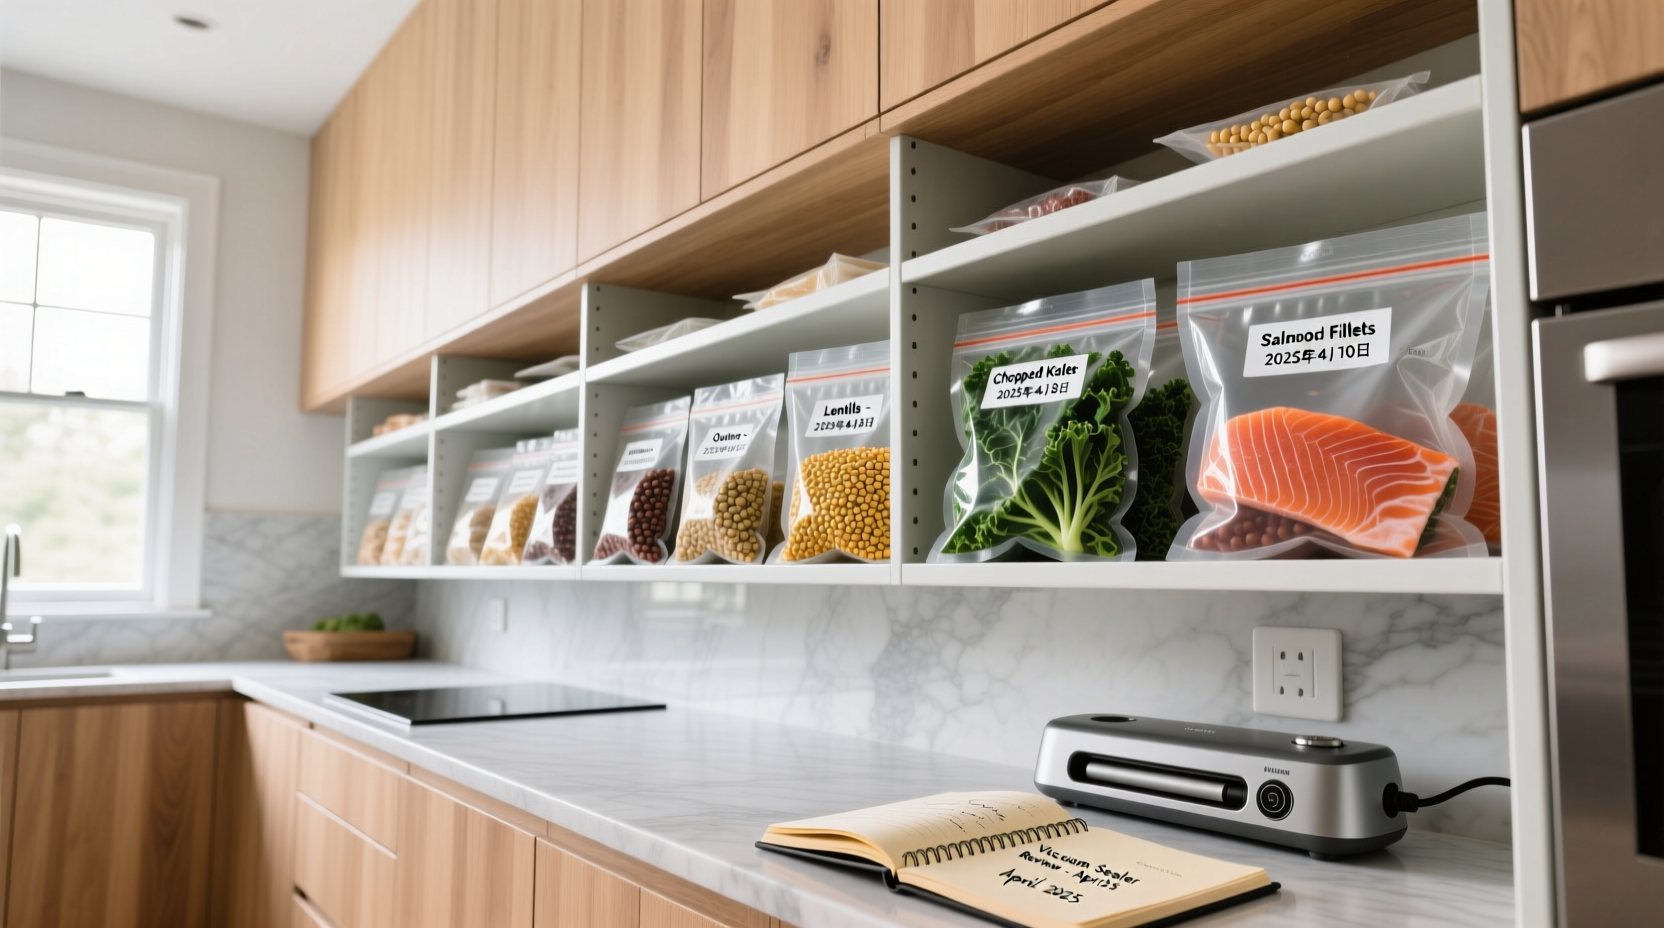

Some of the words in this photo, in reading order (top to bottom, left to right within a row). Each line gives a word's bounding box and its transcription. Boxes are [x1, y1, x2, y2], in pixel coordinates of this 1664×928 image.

[1329, 321, 1376, 340] Fillets
[993, 366, 1043, 385] Chopped
[998, 868, 1047, 889] April
